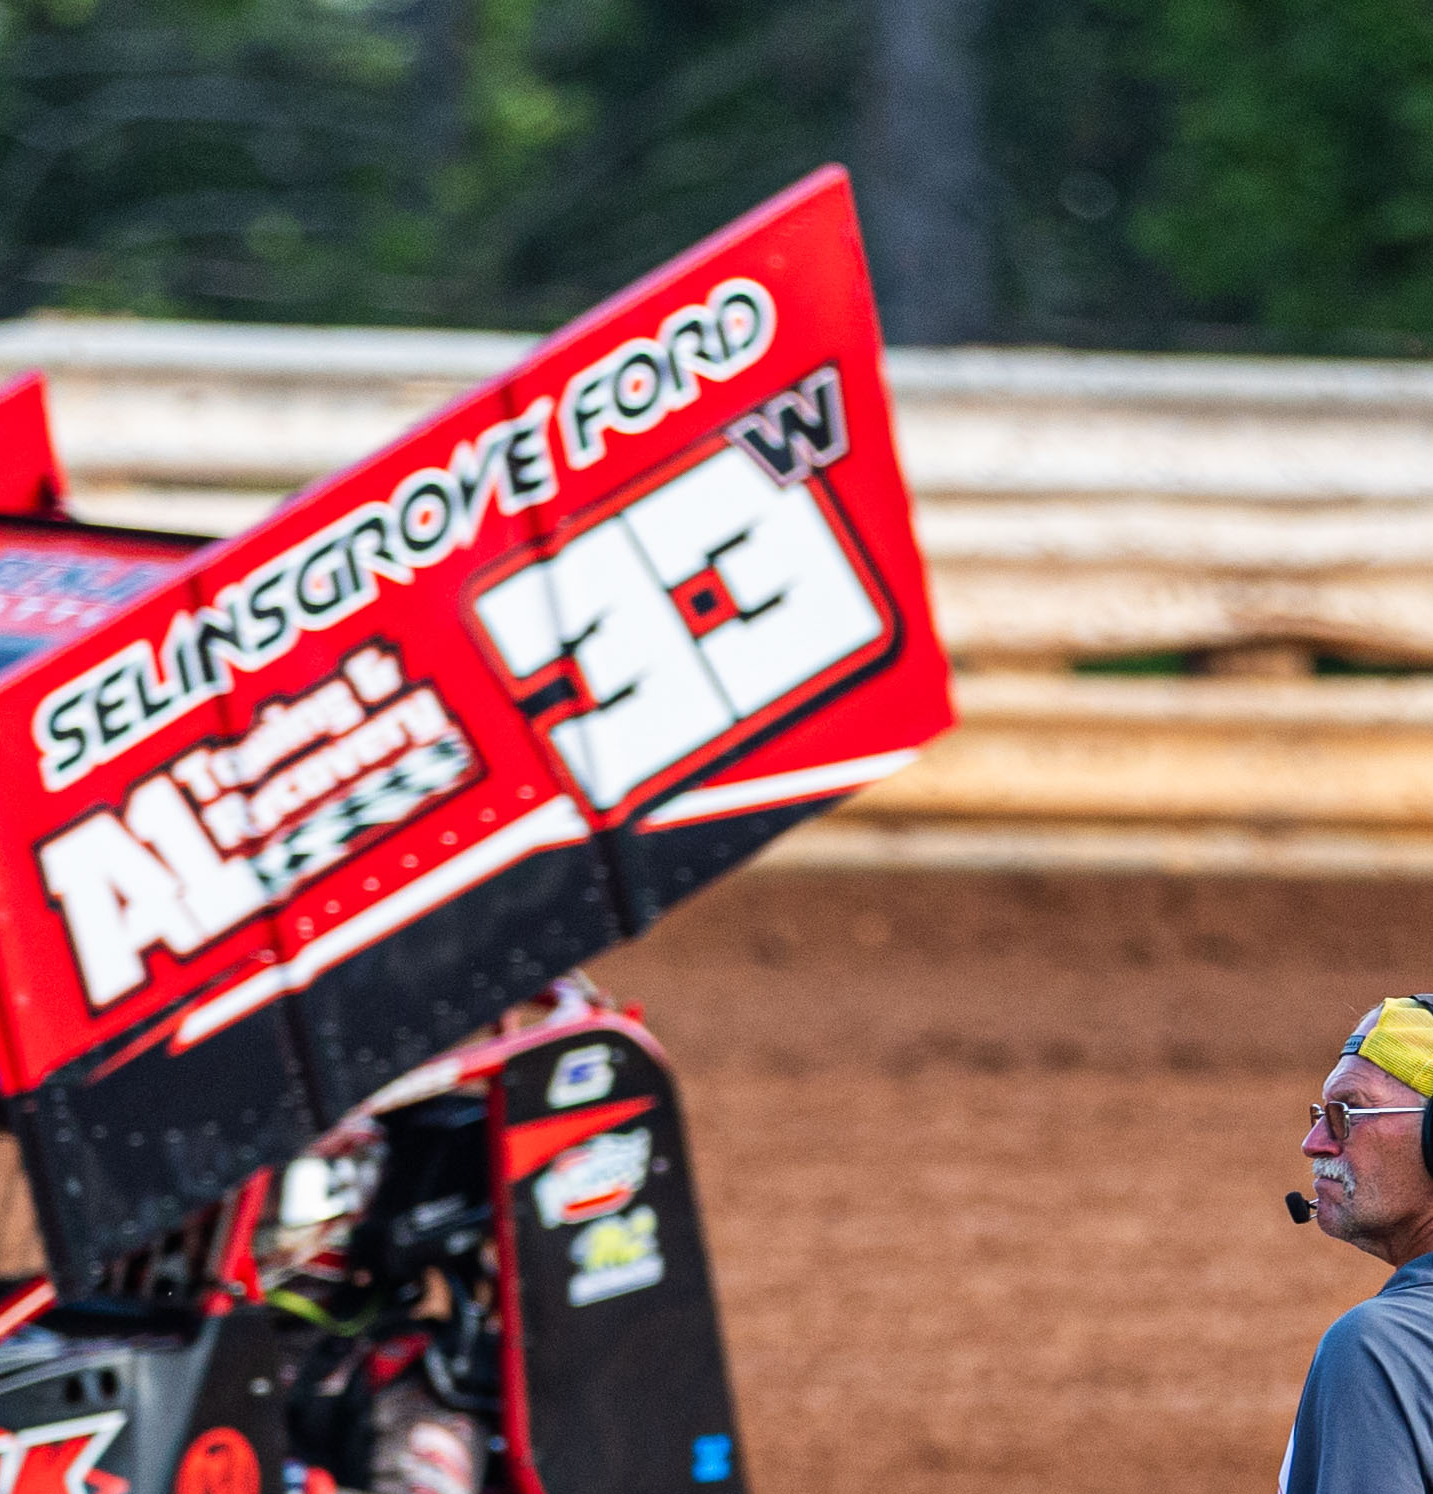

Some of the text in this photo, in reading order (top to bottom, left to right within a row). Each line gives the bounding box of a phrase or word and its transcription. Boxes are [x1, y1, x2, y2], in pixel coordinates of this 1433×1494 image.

[36, 281, 773, 786] SELINSGROVE FORD
[172, 648, 403, 803] Towing &
[201, 688, 450, 849] Recovery
